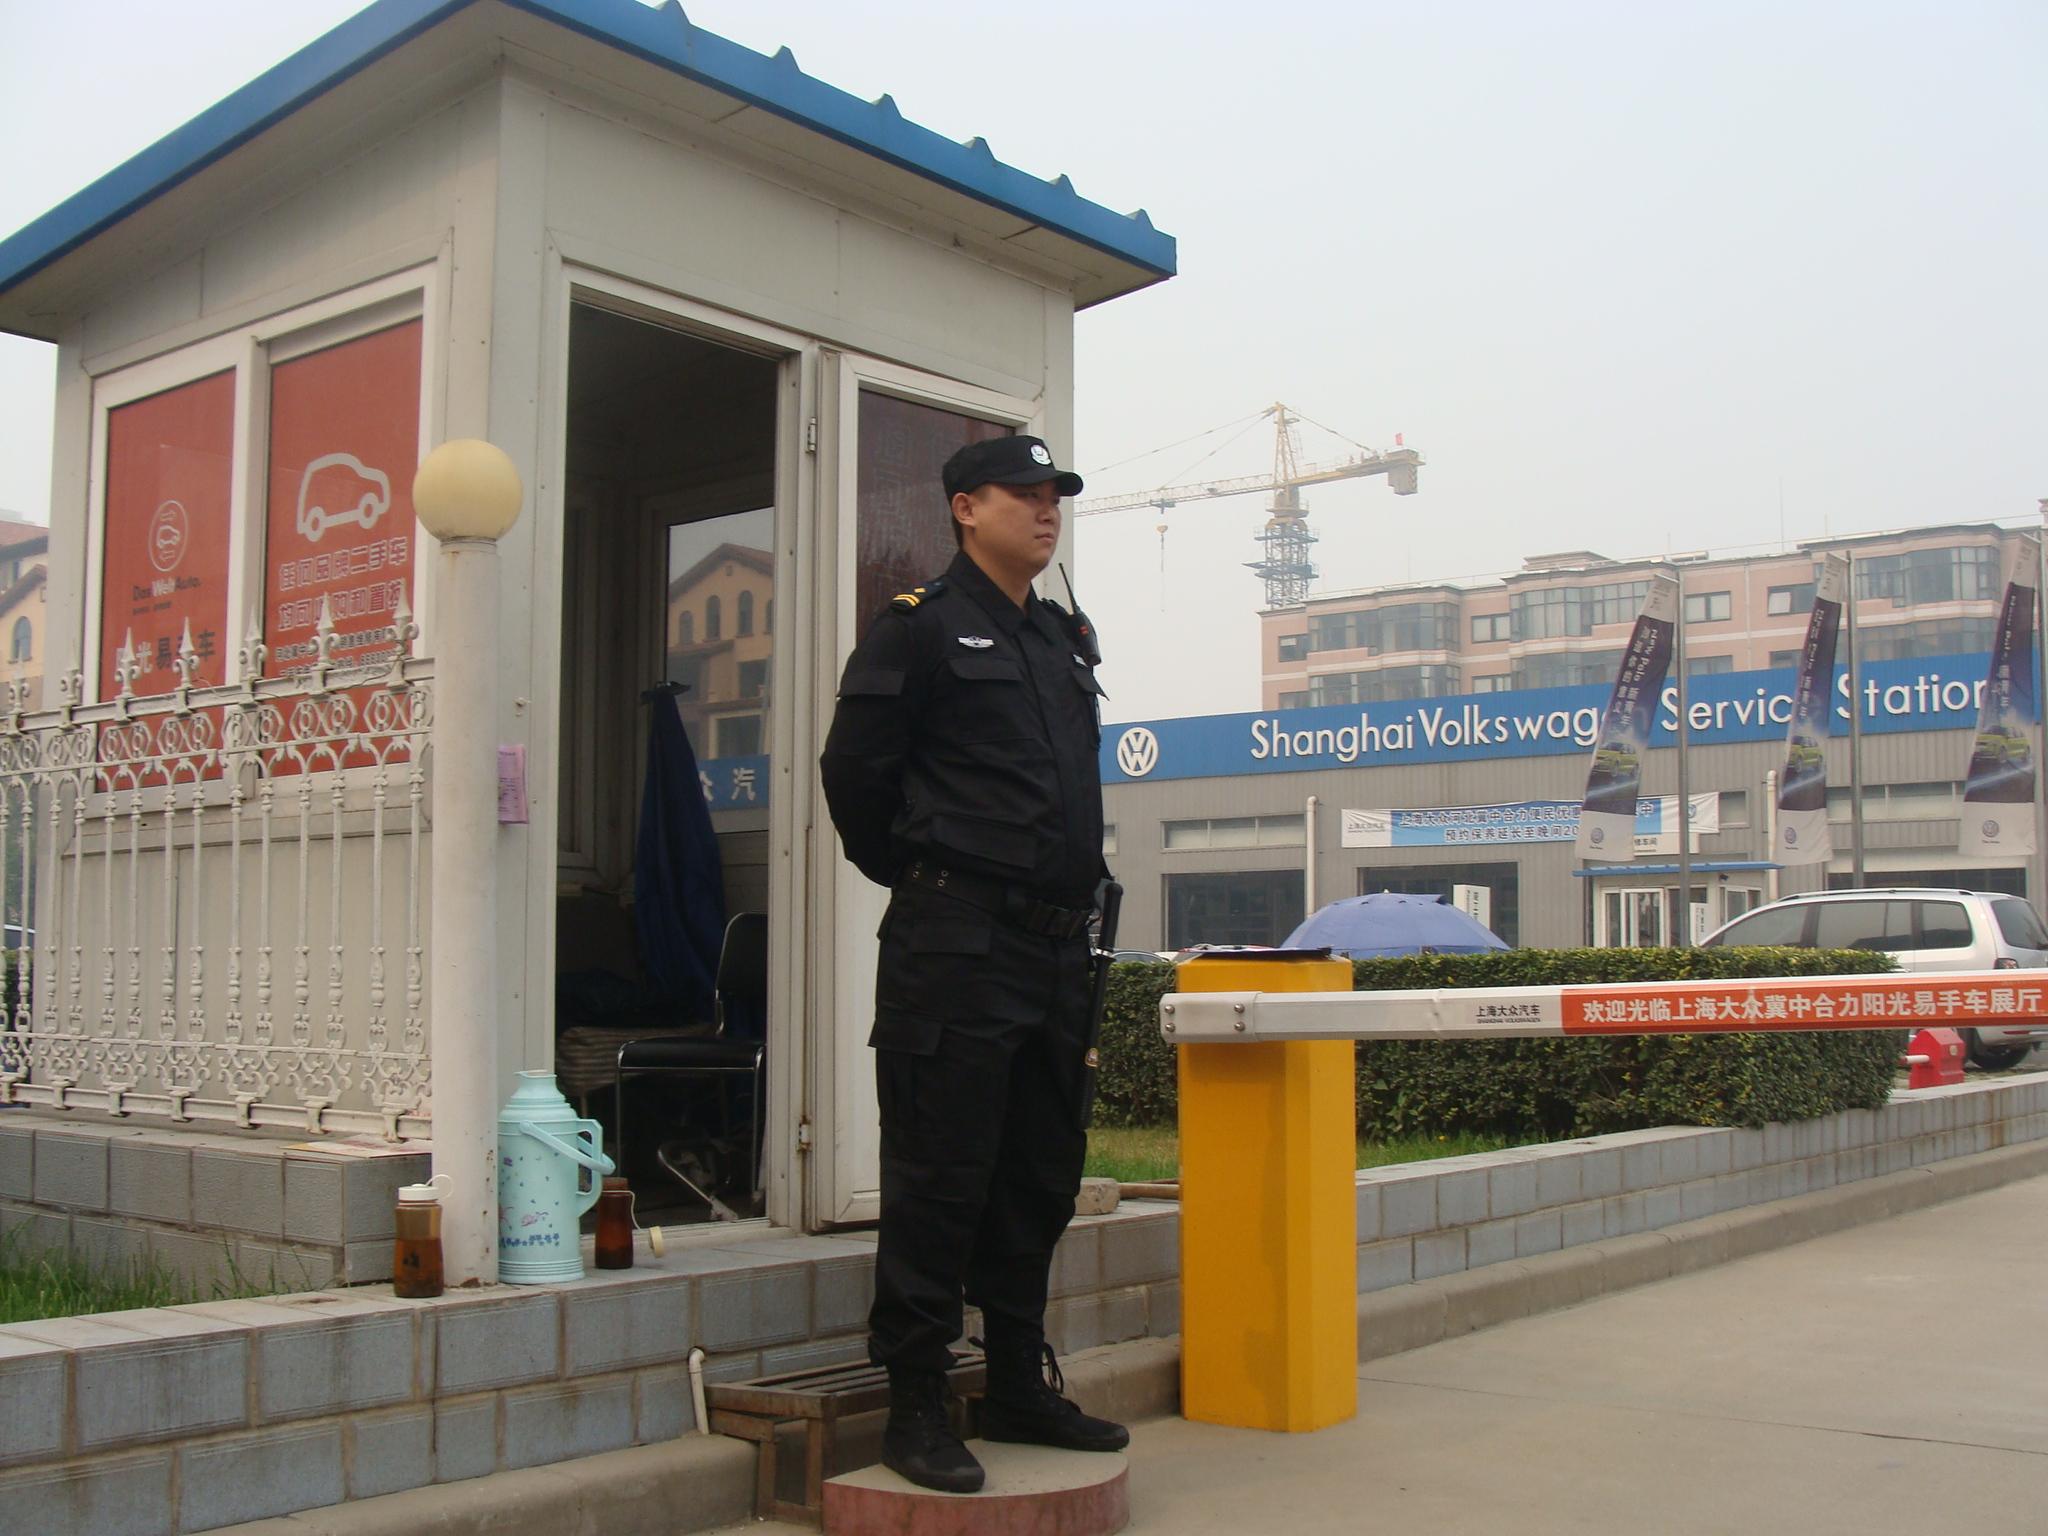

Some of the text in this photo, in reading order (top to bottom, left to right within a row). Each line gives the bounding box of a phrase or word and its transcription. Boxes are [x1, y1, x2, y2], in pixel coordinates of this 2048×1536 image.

[116, 630, 216, 674] 光易车
[1251, 713, 1413, 762] Shanghai
[1660, 687, 1794, 731] Servic
[1476, 1004, 1541, 1017] 上海大众汽车
[1583, 988, 2042, 1023] 欢迎光临上海大众冀中合力阳光易手车展厅
